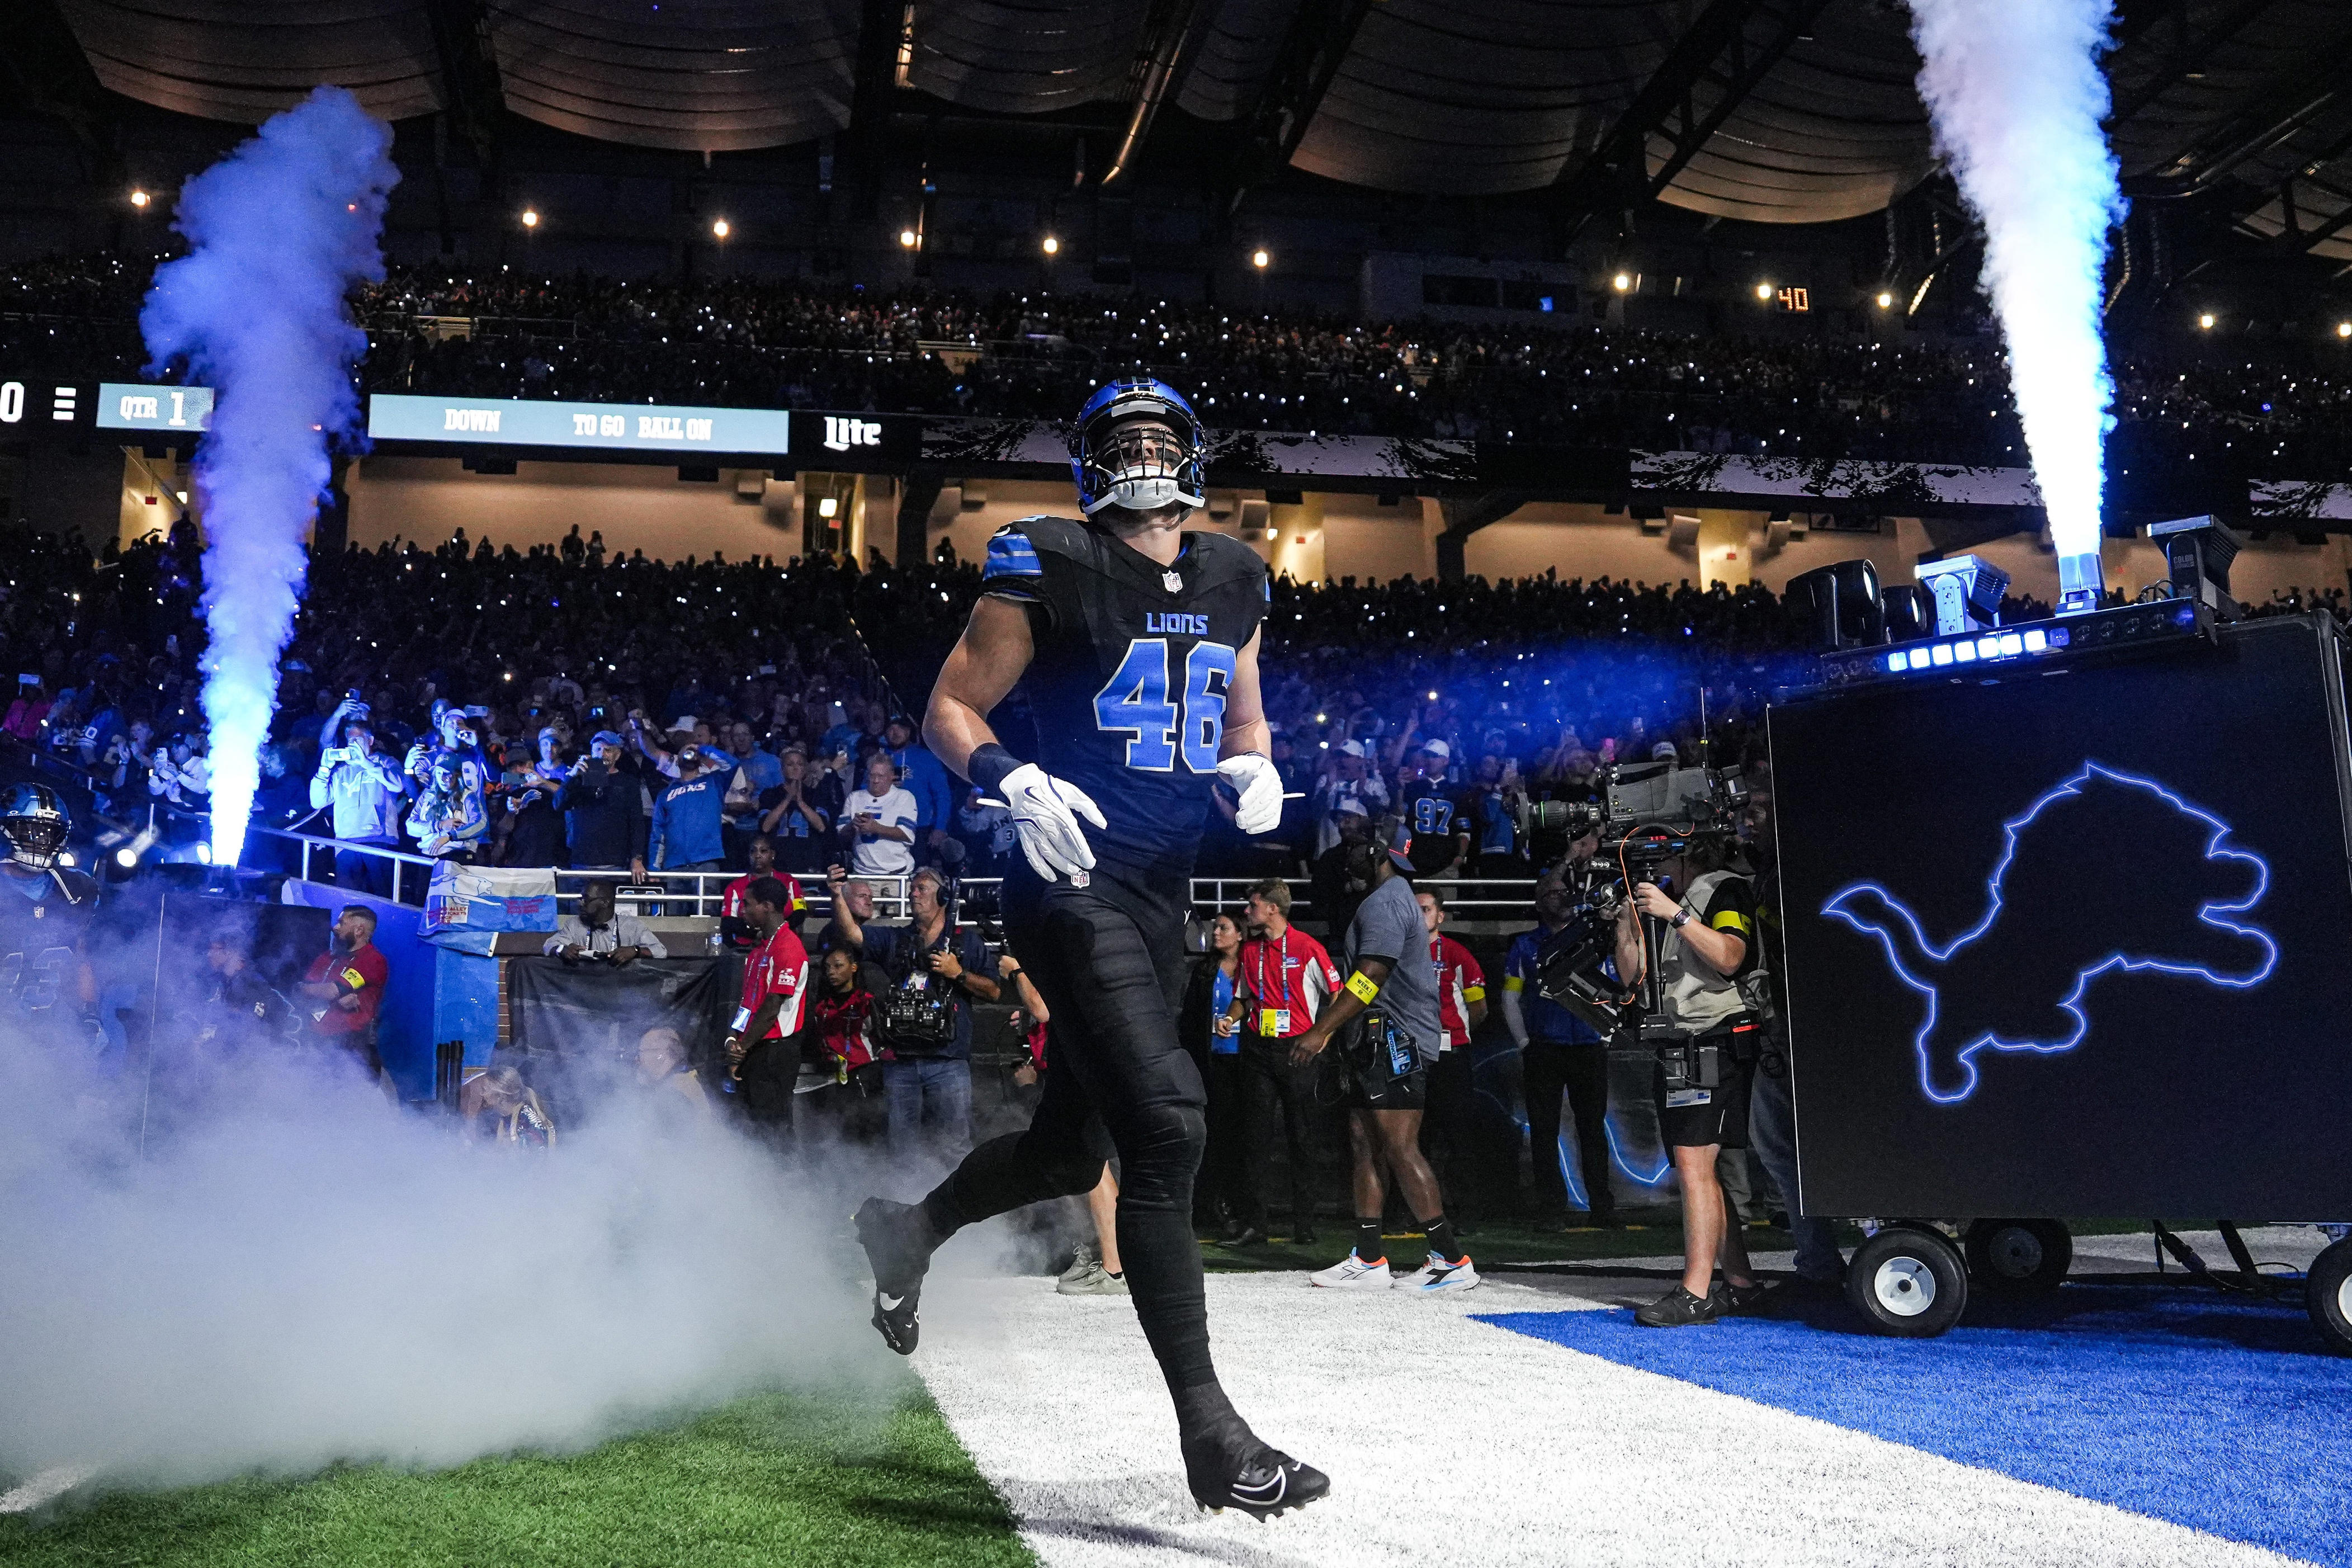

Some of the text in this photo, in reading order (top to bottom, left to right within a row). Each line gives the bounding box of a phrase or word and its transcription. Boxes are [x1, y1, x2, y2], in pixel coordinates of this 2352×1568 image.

[1778, 287, 1808, 311] 40
[0, 381, 25, 422] 0
[120, 391, 186, 426] QTR 1
[444, 409, 501, 432] DOWN
[573, 414, 625, 437] TO GO
[637, 416, 713, 441] BALL ON
[823, 416, 881, 451] Lite
[1167, 579, 1180, 589] NFL
[1146, 612, 1208, 635] LIONS
[1093, 637, 1236, 774] 46
[1415, 797, 1454, 835] 97
[1357, 979, 1369, 991] WEEK
[1387, 1033, 1398, 1061] MONDAY
